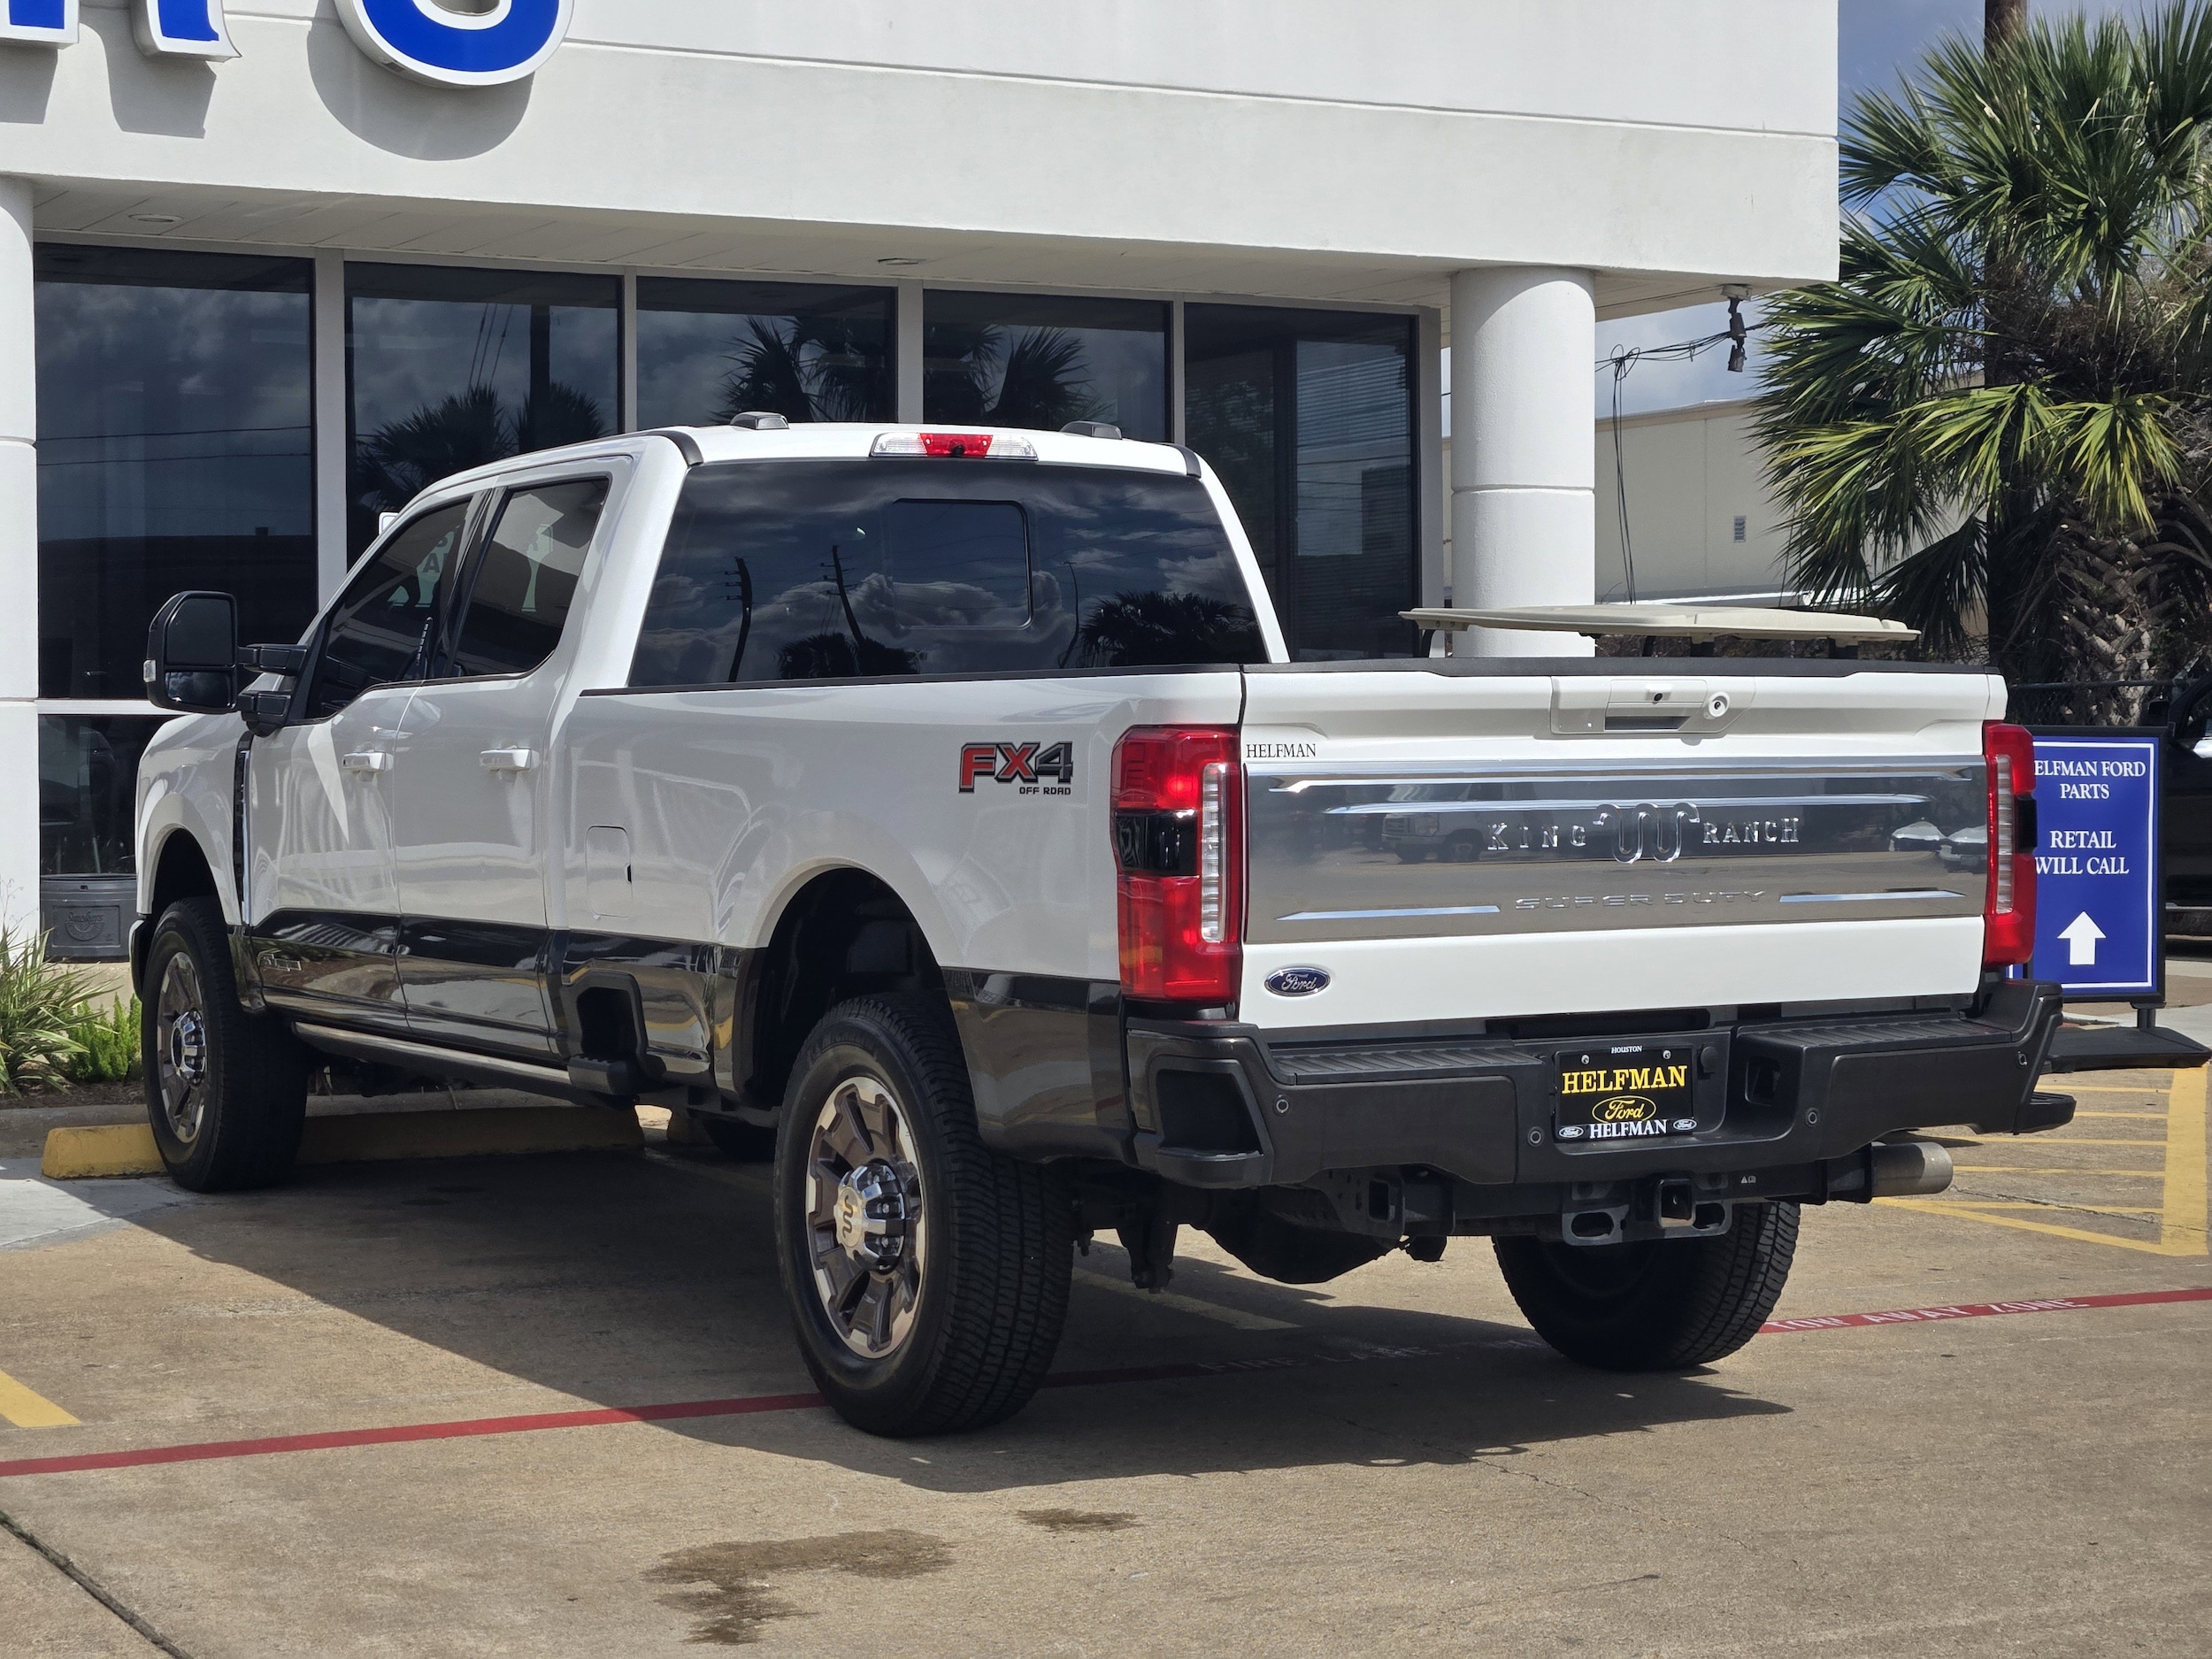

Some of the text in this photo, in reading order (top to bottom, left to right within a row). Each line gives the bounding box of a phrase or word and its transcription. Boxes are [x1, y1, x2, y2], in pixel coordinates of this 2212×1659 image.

[1246, 743, 1317, 758] HELFMAN
[958, 741, 1074, 794] FX4
[2034, 760, 2147, 778] ELFMAN FORD
[1018, 787, 1071, 795] OFF ROAD
[2060, 783, 2110, 799] PARTS
[1487, 817, 1800, 850] KING RANCH
[2049, 830, 2116, 849] RETAIL
[2035, 856, 2130, 875] WILL CALL
[1515, 890, 1766, 910] SUPER DUTY
[1562, 1065, 1687, 1094] HELFMAN
[1605, 1100, 1645, 1119] Ford
[1590, 1119, 1668, 1139] HELFMAN
[1764, 1299, 2091, 1331] TOW AWAY ZONE
